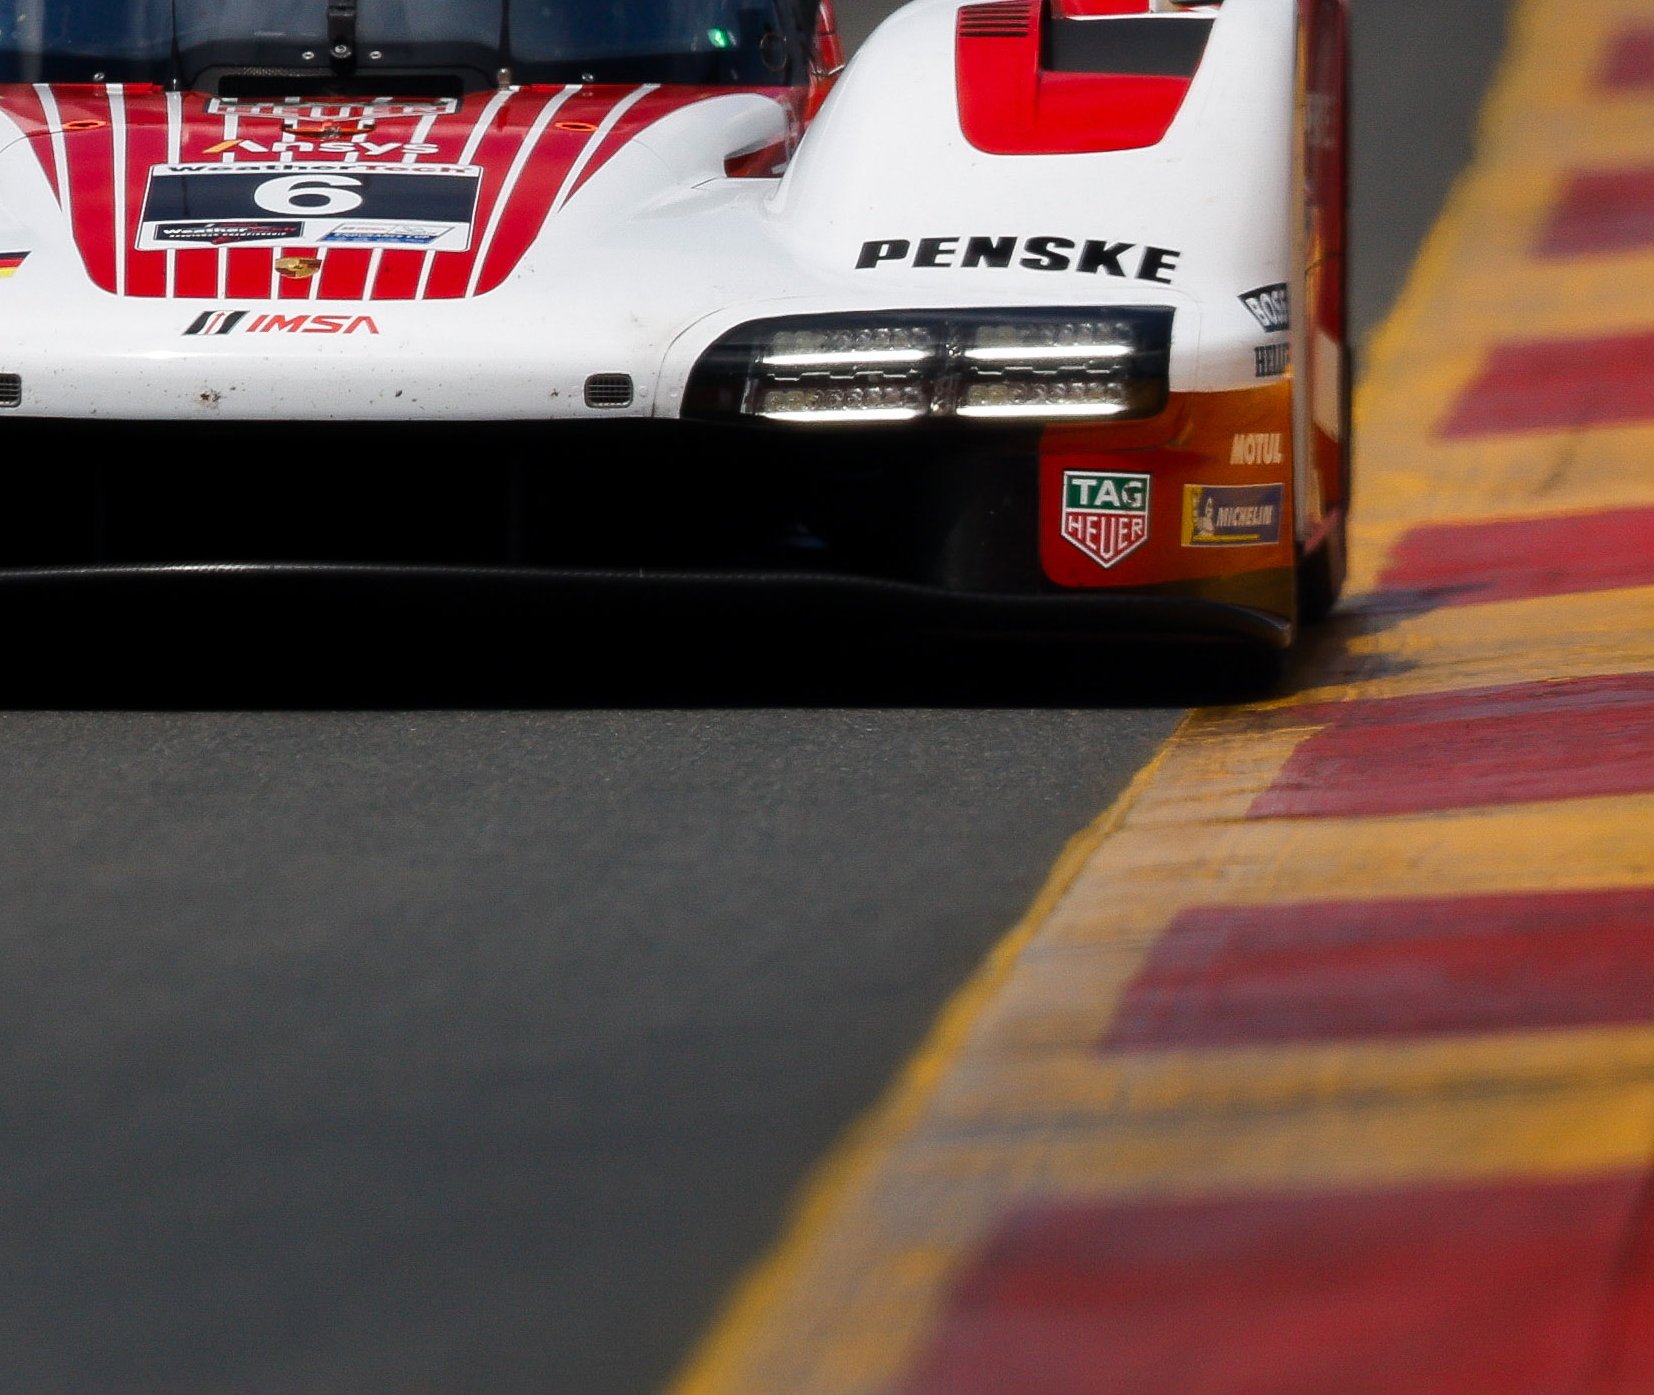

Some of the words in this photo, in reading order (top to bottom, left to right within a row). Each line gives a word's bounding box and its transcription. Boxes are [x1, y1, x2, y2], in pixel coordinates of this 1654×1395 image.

[202, 139, 439, 156] Ansys
[168, 164, 468, 174] WeatherTech
[253, 174, 363, 216] 6
[855, 236, 1181, 284] PENSKE
[245, 314, 380, 334] IMSA
[1229, 432, 1283, 465] MOTUL
[1071, 478, 1143, 508] TAG
[1215, 504, 1274, 527] MICHELIN
[1067, 514, 1143, 559] HEUER
